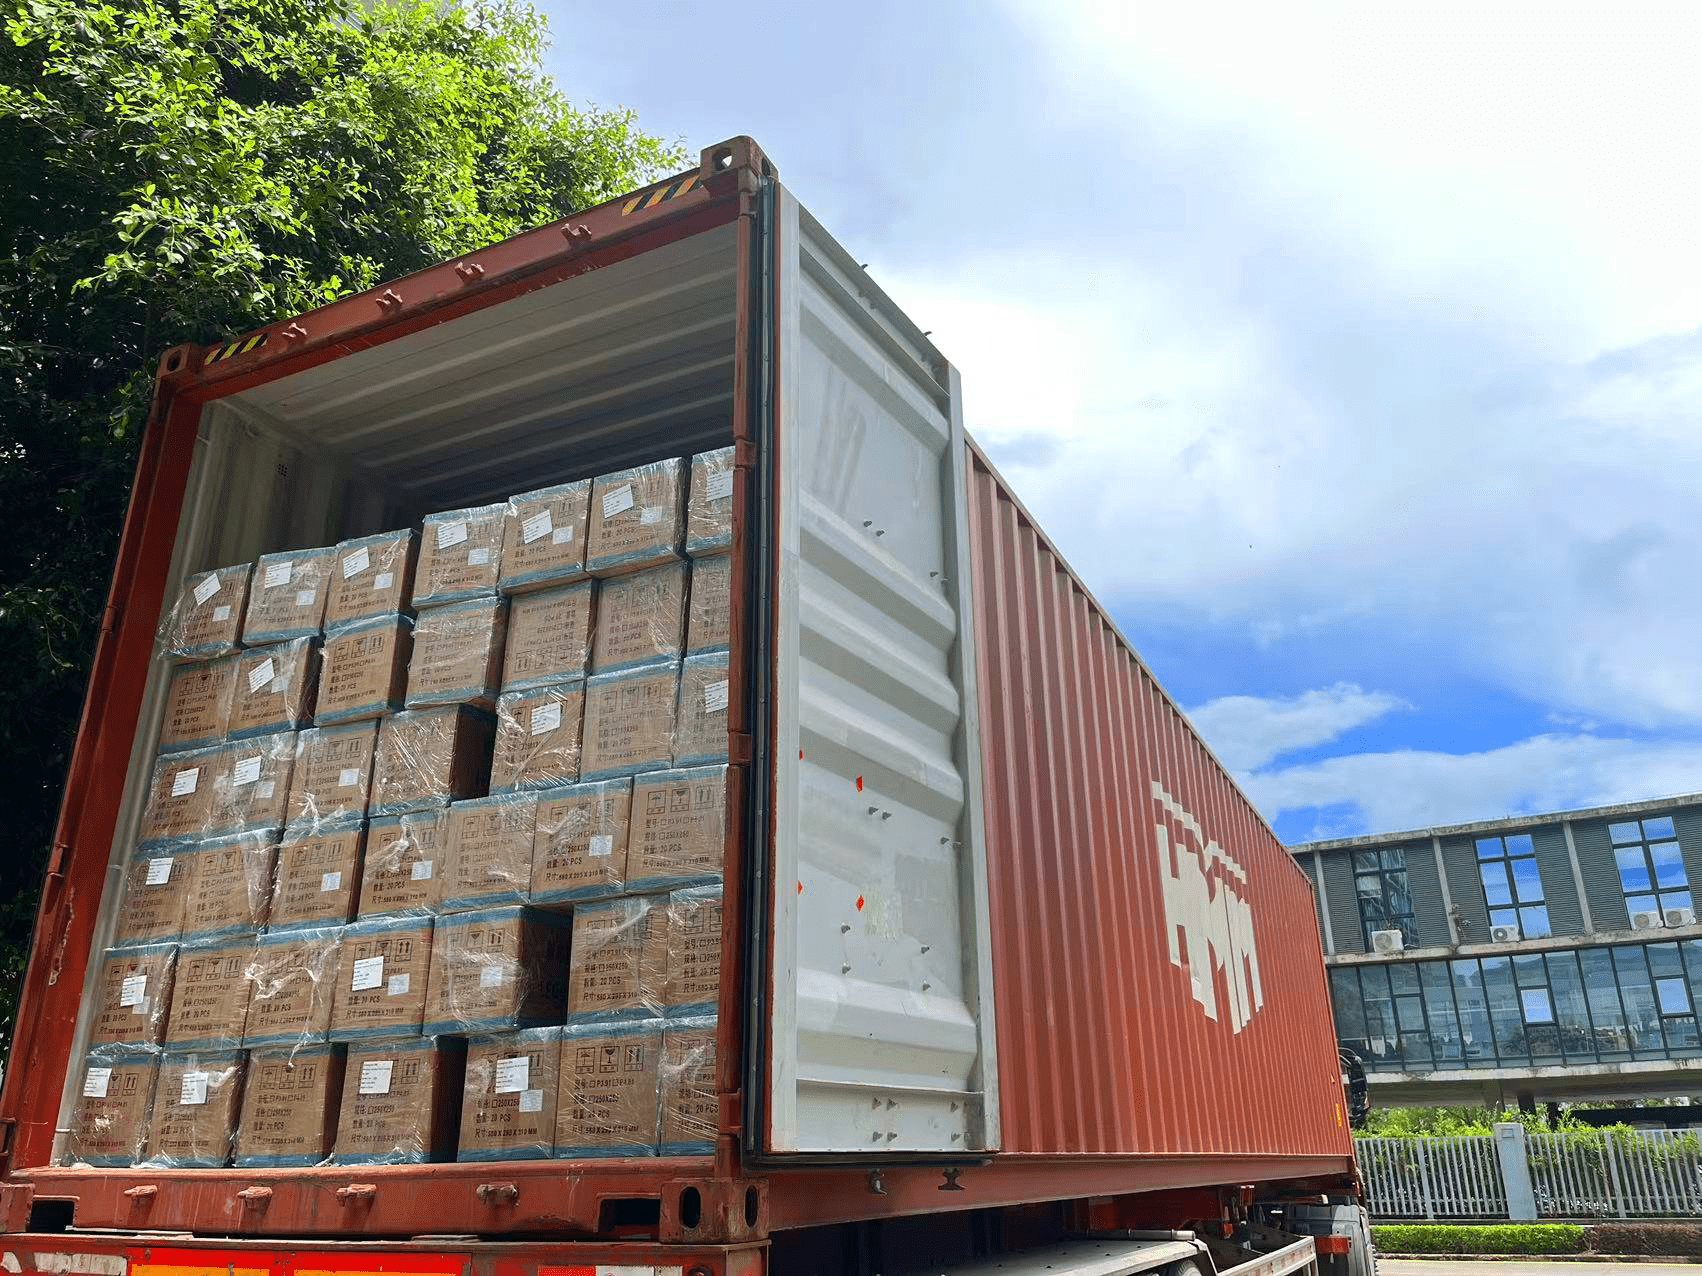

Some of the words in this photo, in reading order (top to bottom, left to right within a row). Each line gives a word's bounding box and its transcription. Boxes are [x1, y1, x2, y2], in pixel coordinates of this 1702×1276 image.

[608, 976, 621, 985] PCS
[696, 1105, 704, 1114] 20
[706, 1104, 719, 1112] PCS
[500, 1113, 512, 1122] PCS
[598, 1110, 610, 1118] PCS
